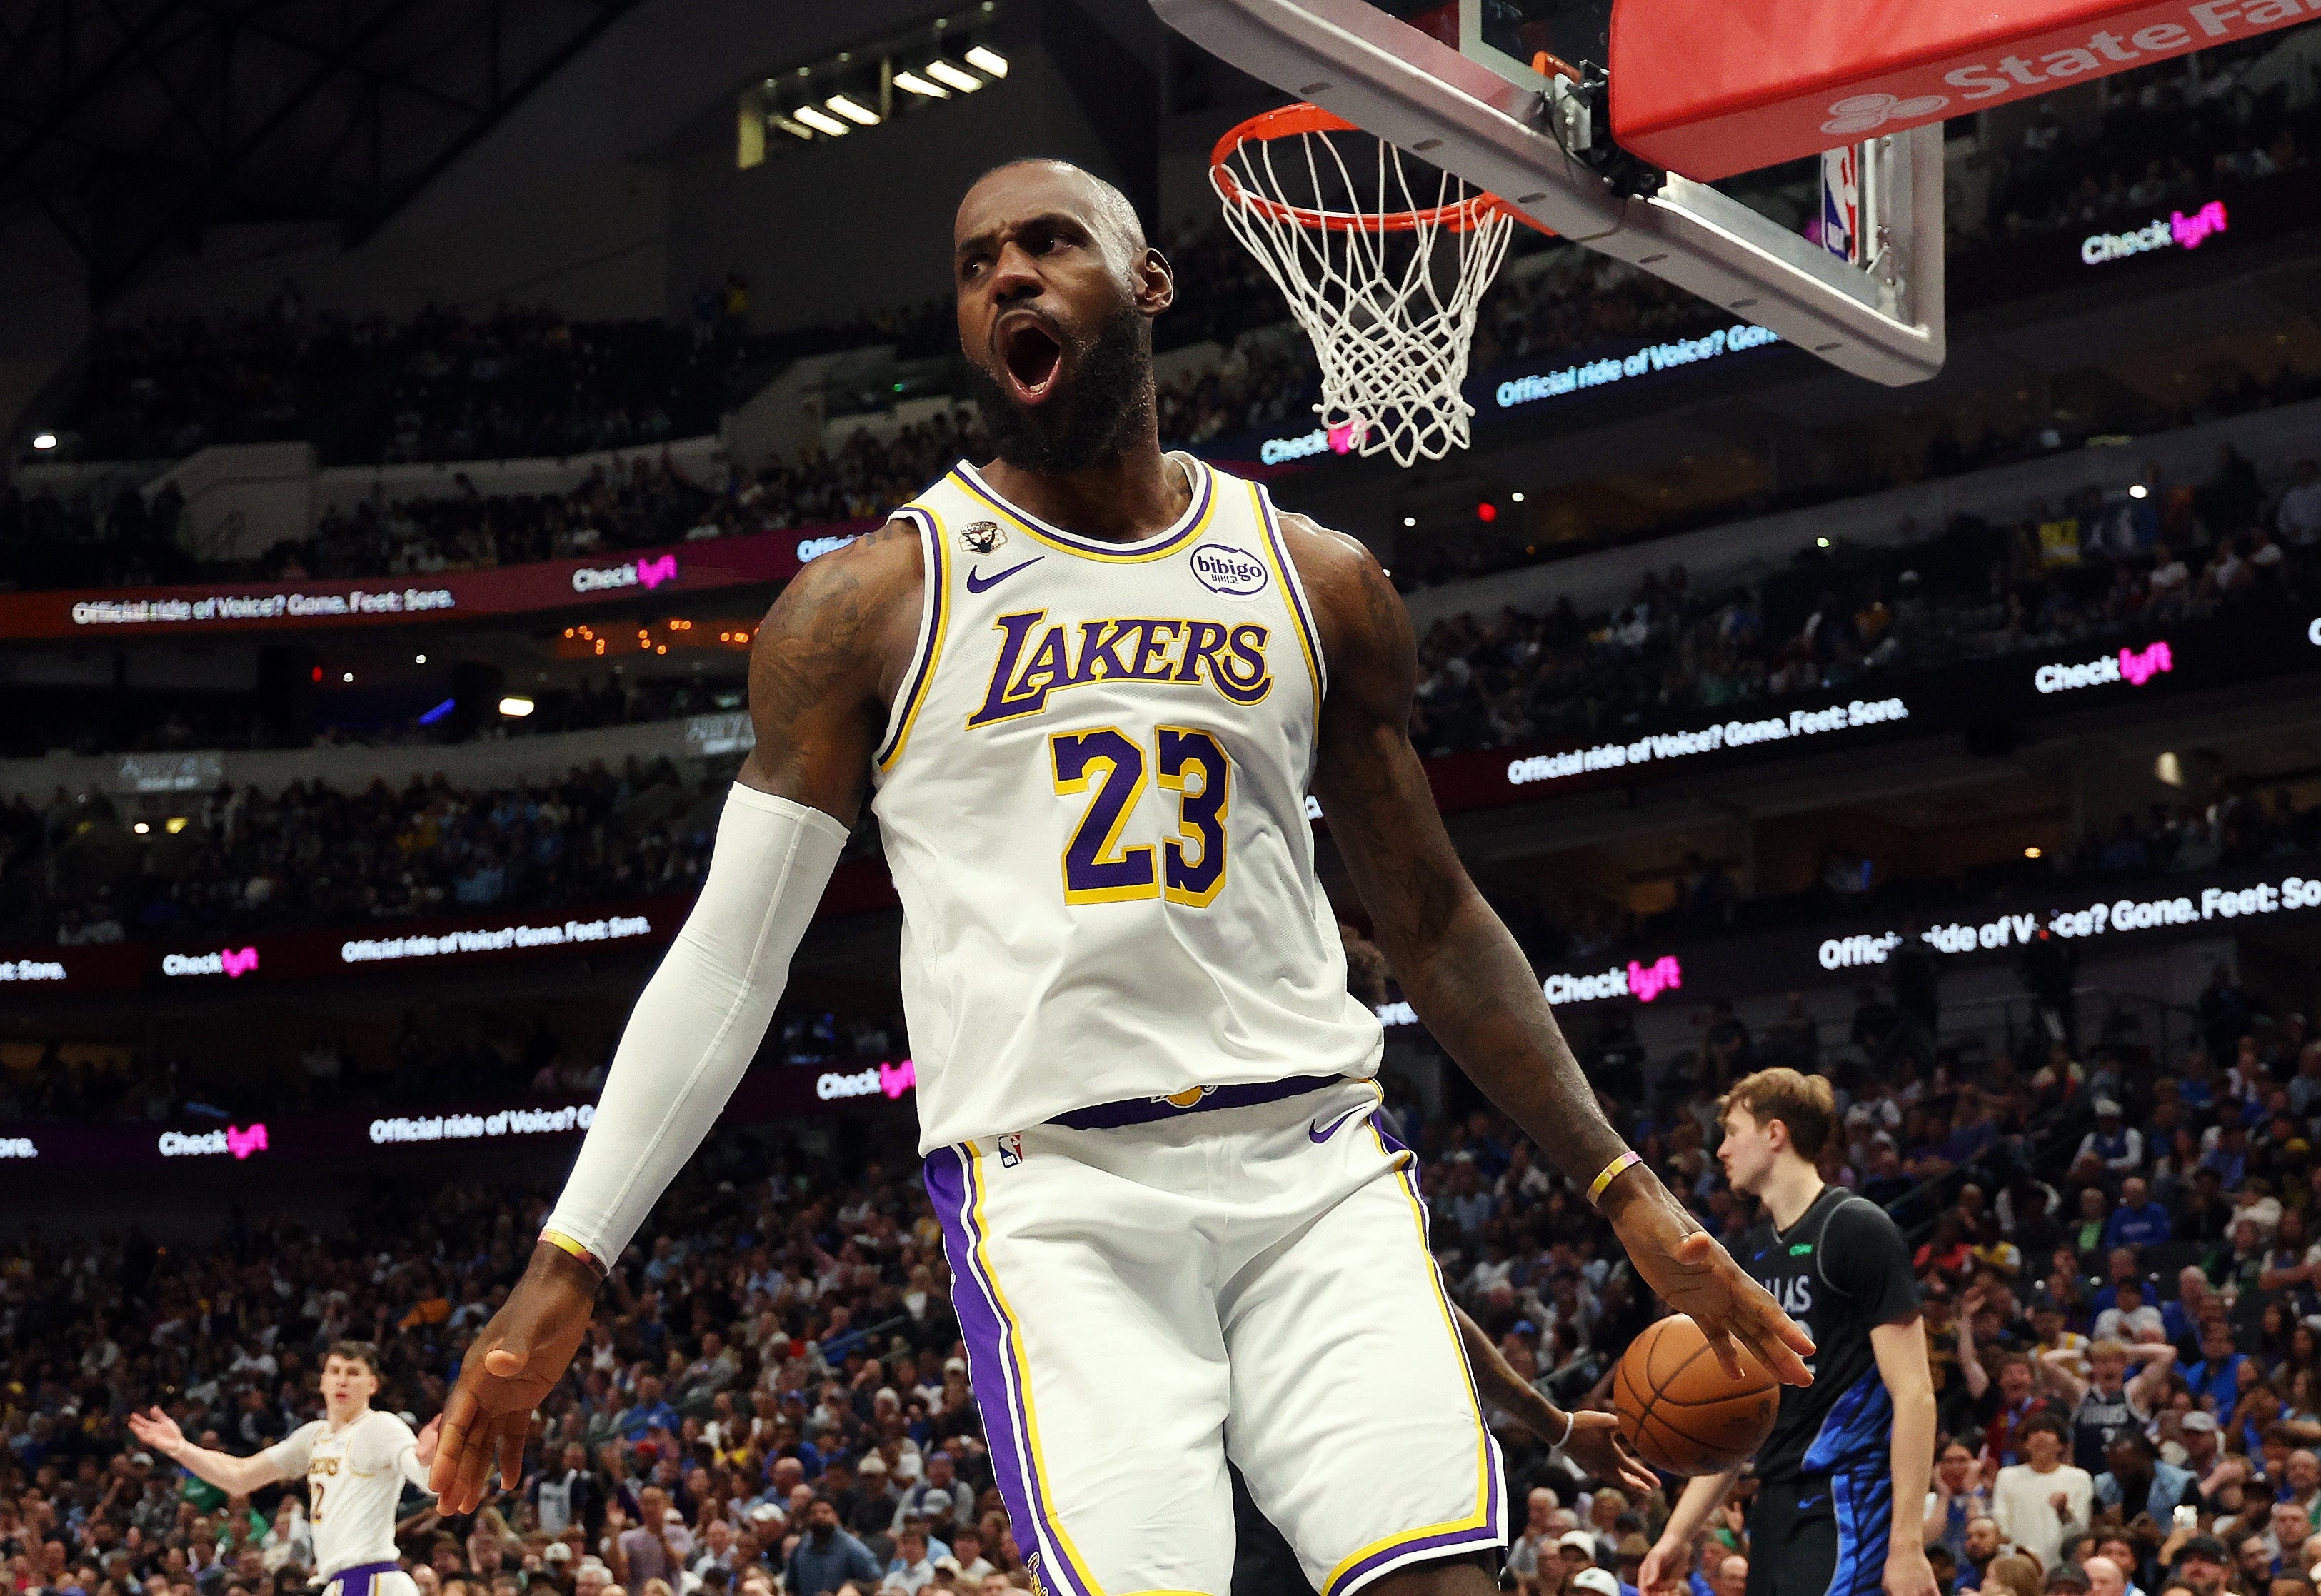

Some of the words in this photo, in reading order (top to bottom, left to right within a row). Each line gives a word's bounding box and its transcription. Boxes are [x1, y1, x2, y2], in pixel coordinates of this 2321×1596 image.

[1944, 22, 2192, 100] State
[2188, 0, 2321, 37] Fa
[2081, 219, 2172, 264] Check
[1496, 366, 1577, 408] Official
[1577, 357, 1623, 389] ride
[1623, 348, 1649, 377] of
[1649, 329, 1726, 371] Voice?
[1727, 324, 1778, 352] Gon
[1197, 556, 1262, 581] bibigo
[1211, 574, 1239, 584] 비비고
[965, 608, 1273, 732] LAKERS
[2035, 655, 2120, 693] Check
[1508, 748, 1584, 785] Official
[1584, 743, 1627, 772] ride
[1627, 736, 1652, 764] of
[1652, 723, 1724, 759] Voice?
[1724, 717, 1790, 748] Gone.
[1790, 705, 1848, 736] Feet:
[1848, 697, 1908, 726] Sore.
[1048, 724, 1230, 909] 23
[1921, 923, 1978, 953] ide
[1979, 914, 2011, 950] of
[2110, 897, 2200, 932] Gone.
[2201, 882, 2279, 920] Feet:
[438, 931, 458, 954] of
[1543, 966, 1629, 1005] Check
[369, 1115, 443, 1144] Official
[485, 1110, 508, 1136] of
[508, 1105, 577, 1134] Voice?
